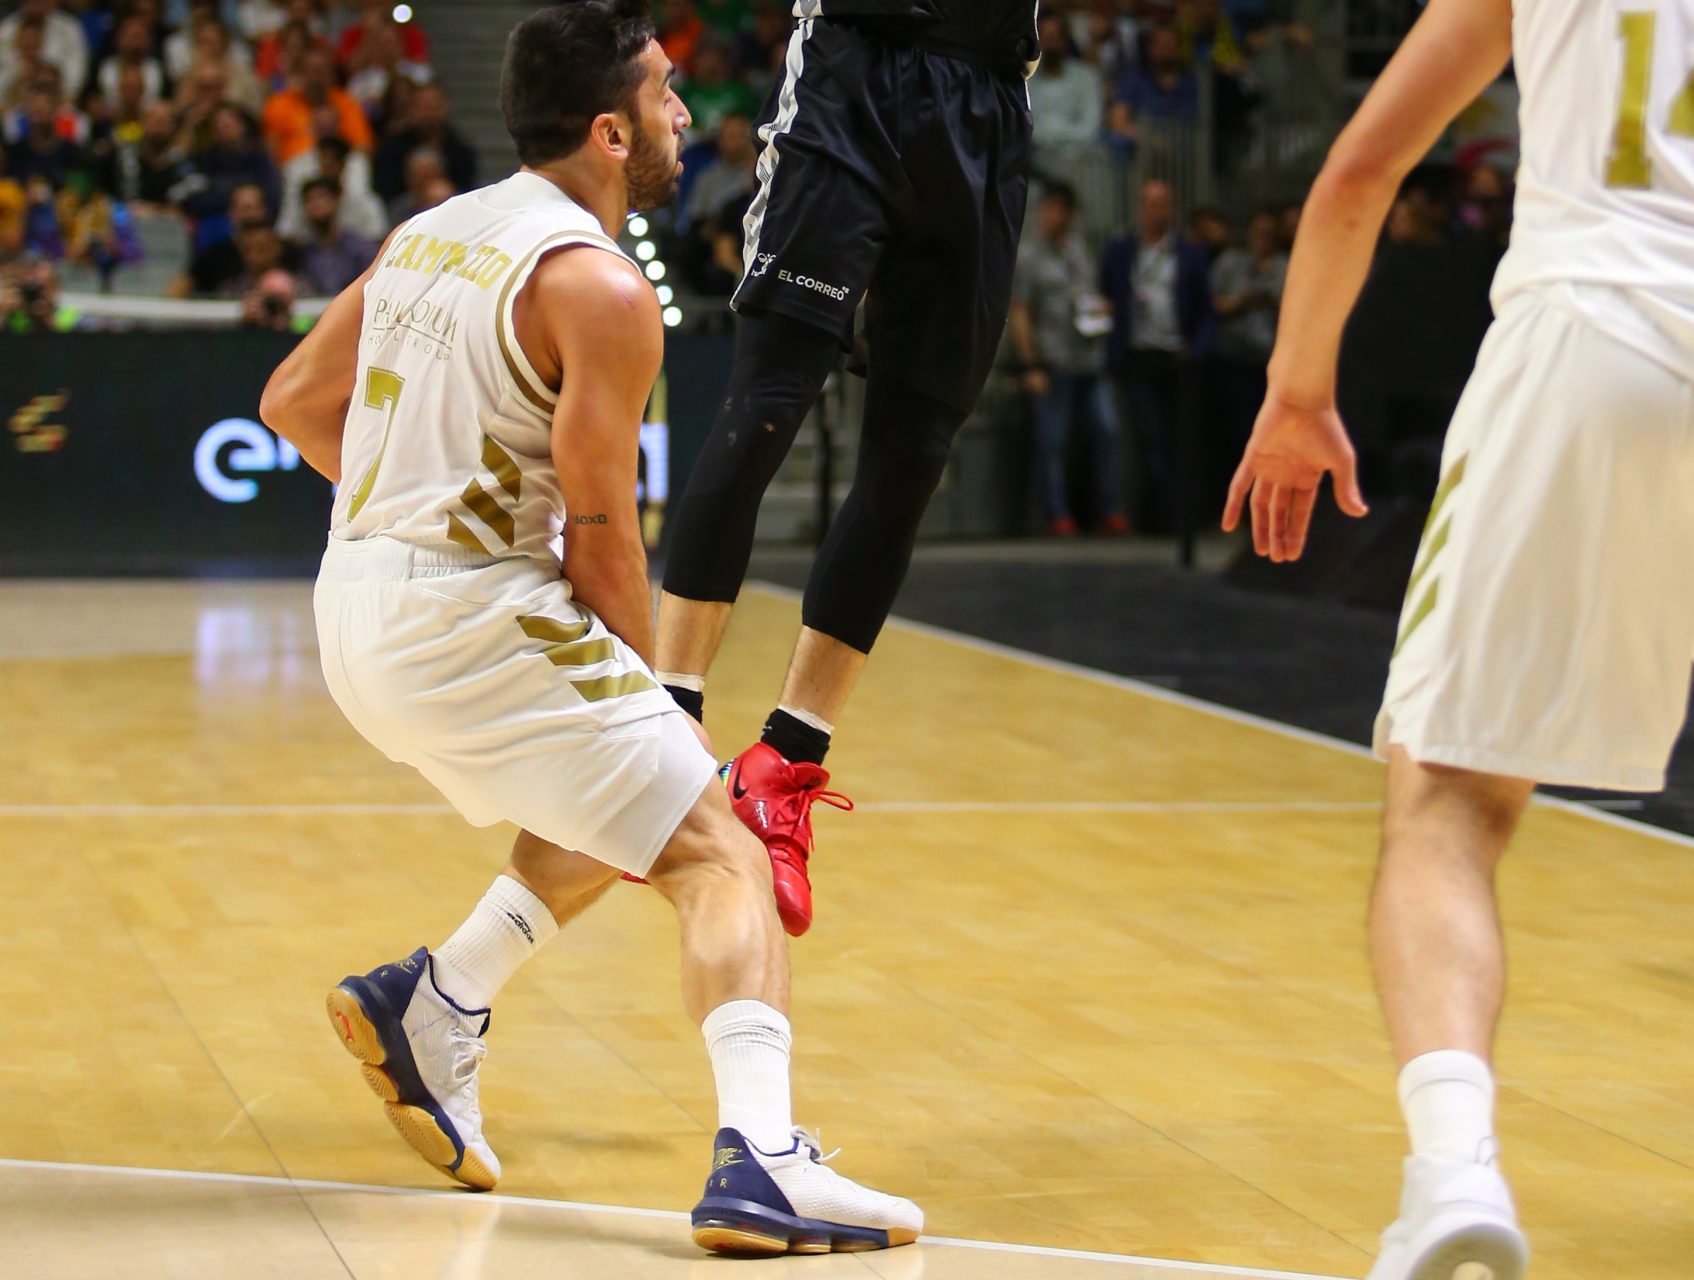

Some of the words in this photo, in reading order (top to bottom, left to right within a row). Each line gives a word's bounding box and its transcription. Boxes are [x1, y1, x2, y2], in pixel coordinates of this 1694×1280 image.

[778, 269, 793, 282] EL
[796, 275, 845, 301] CORREO
[347, 366, 406, 523] 7
